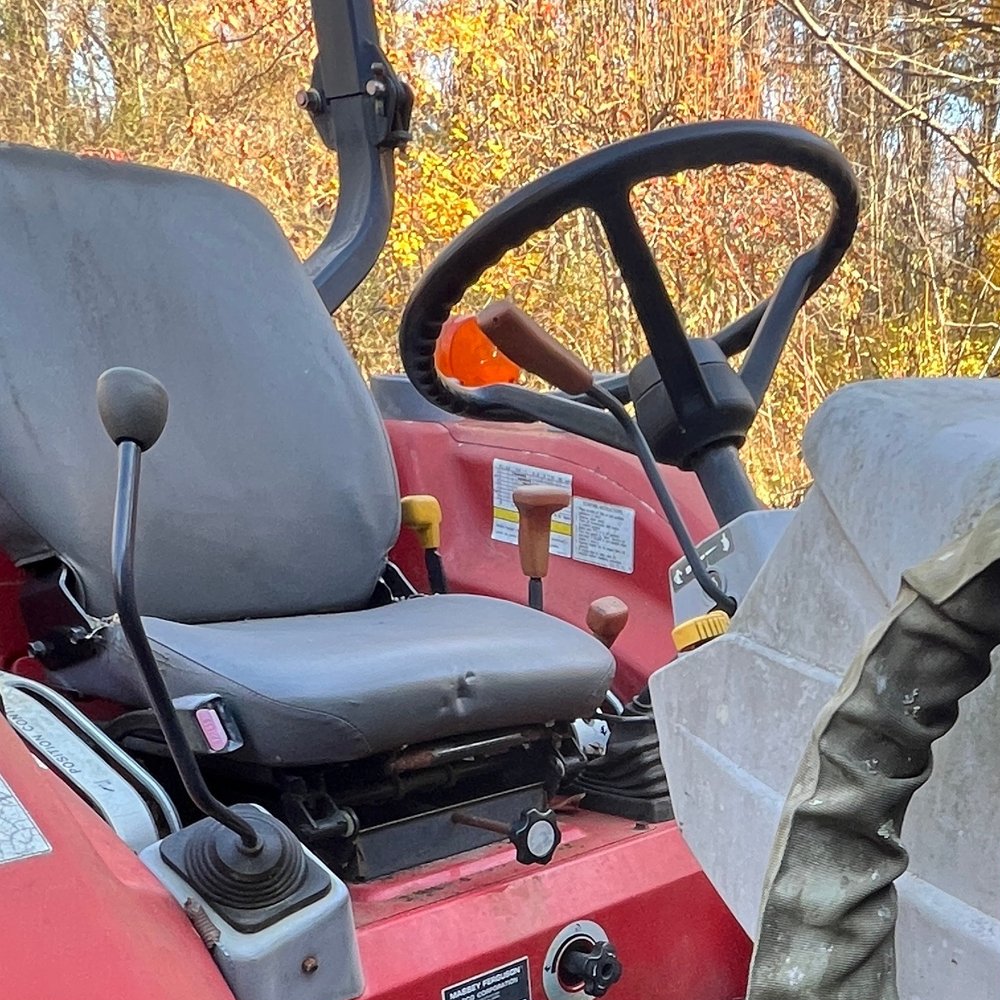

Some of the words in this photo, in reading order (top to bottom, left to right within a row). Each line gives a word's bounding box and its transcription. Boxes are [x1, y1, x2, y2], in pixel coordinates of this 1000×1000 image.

[31, 734, 82, 774] POSITION
[449, 982, 481, 1000] MASSEY
[482, 966, 521, 988] FERGUSON
[477, 977, 518, 998] CORPORATION
